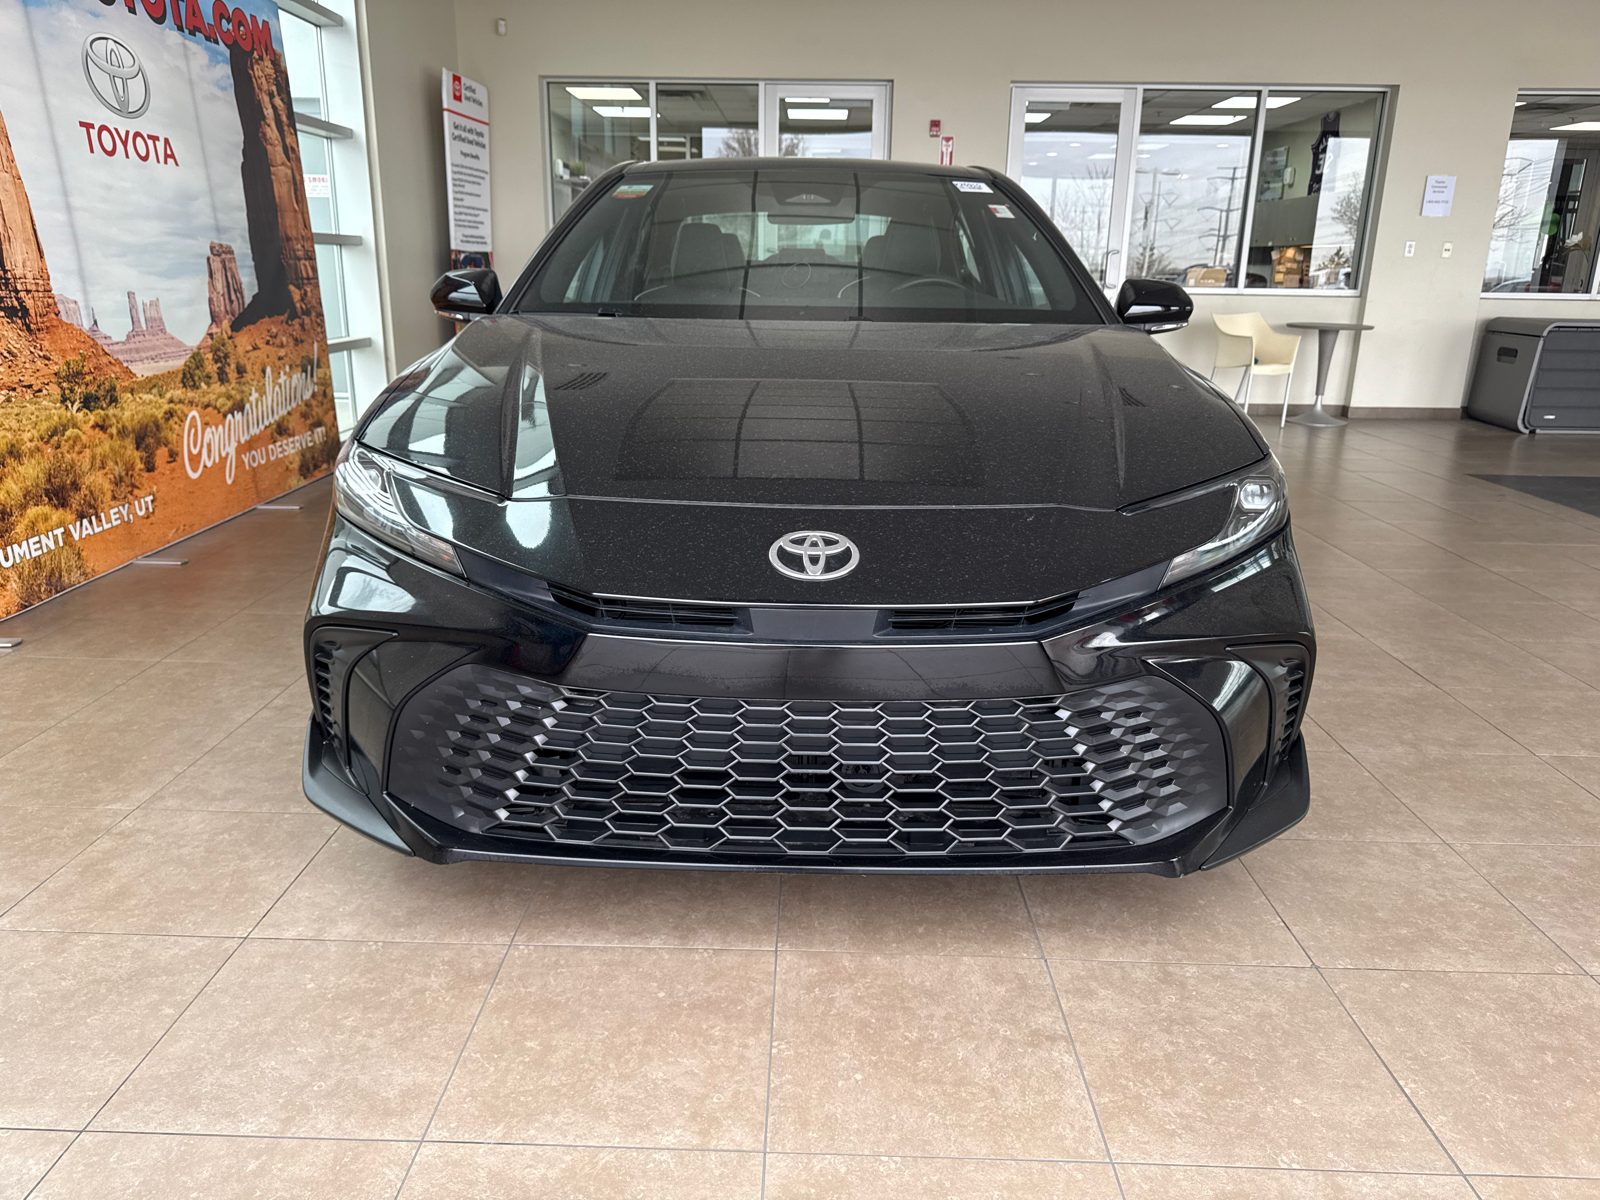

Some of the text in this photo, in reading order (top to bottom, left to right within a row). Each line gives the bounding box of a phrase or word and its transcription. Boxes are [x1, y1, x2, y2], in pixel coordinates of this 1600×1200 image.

[79, 121, 179, 167] TOYOTA
[183, 341, 318, 485] Congratulations!
[241, 426, 327, 471] YOU DESERVE IT!
[68, 503, 134, 542] VALLEY,
[134, 495, 154, 517] UT
